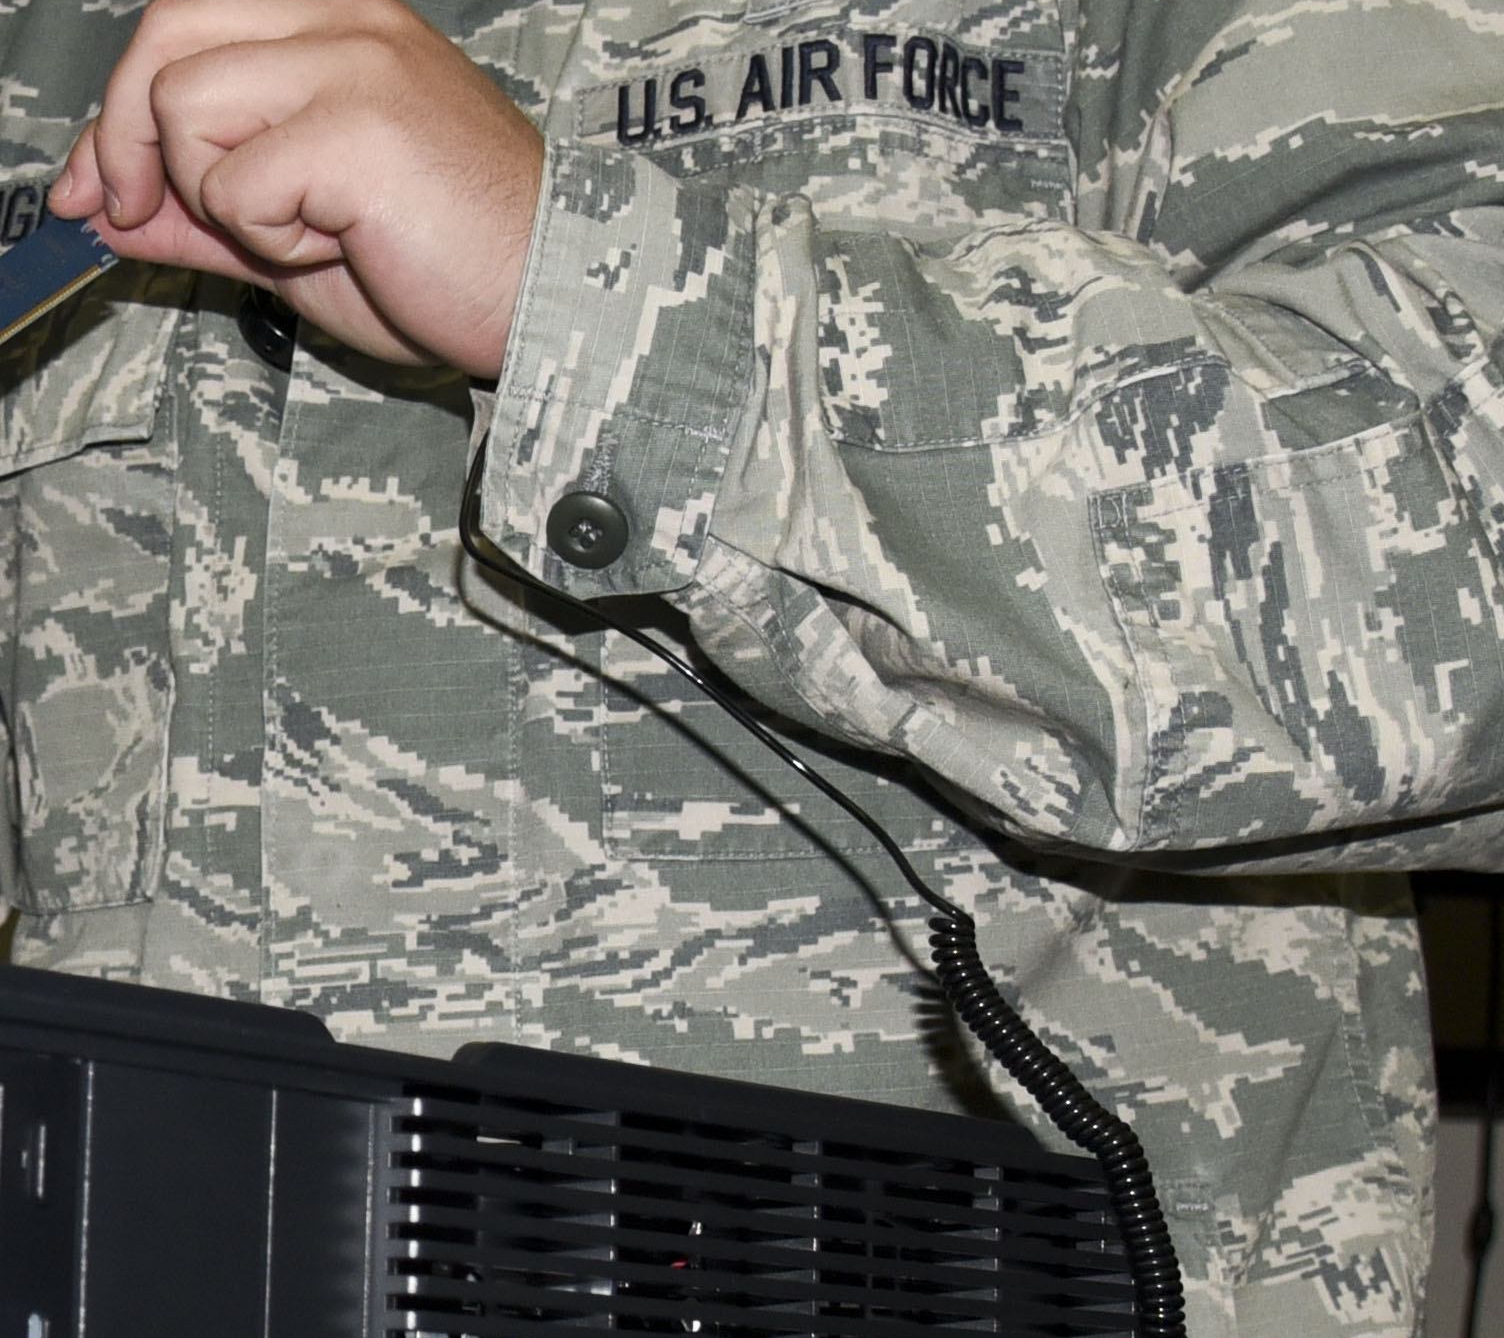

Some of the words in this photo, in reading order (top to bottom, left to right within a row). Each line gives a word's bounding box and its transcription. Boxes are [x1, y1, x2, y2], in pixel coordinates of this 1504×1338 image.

[616, 68, 713, 146] U.S.
[736, 37, 842, 120] AIR
[863, 33, 1025, 132] FORCE
